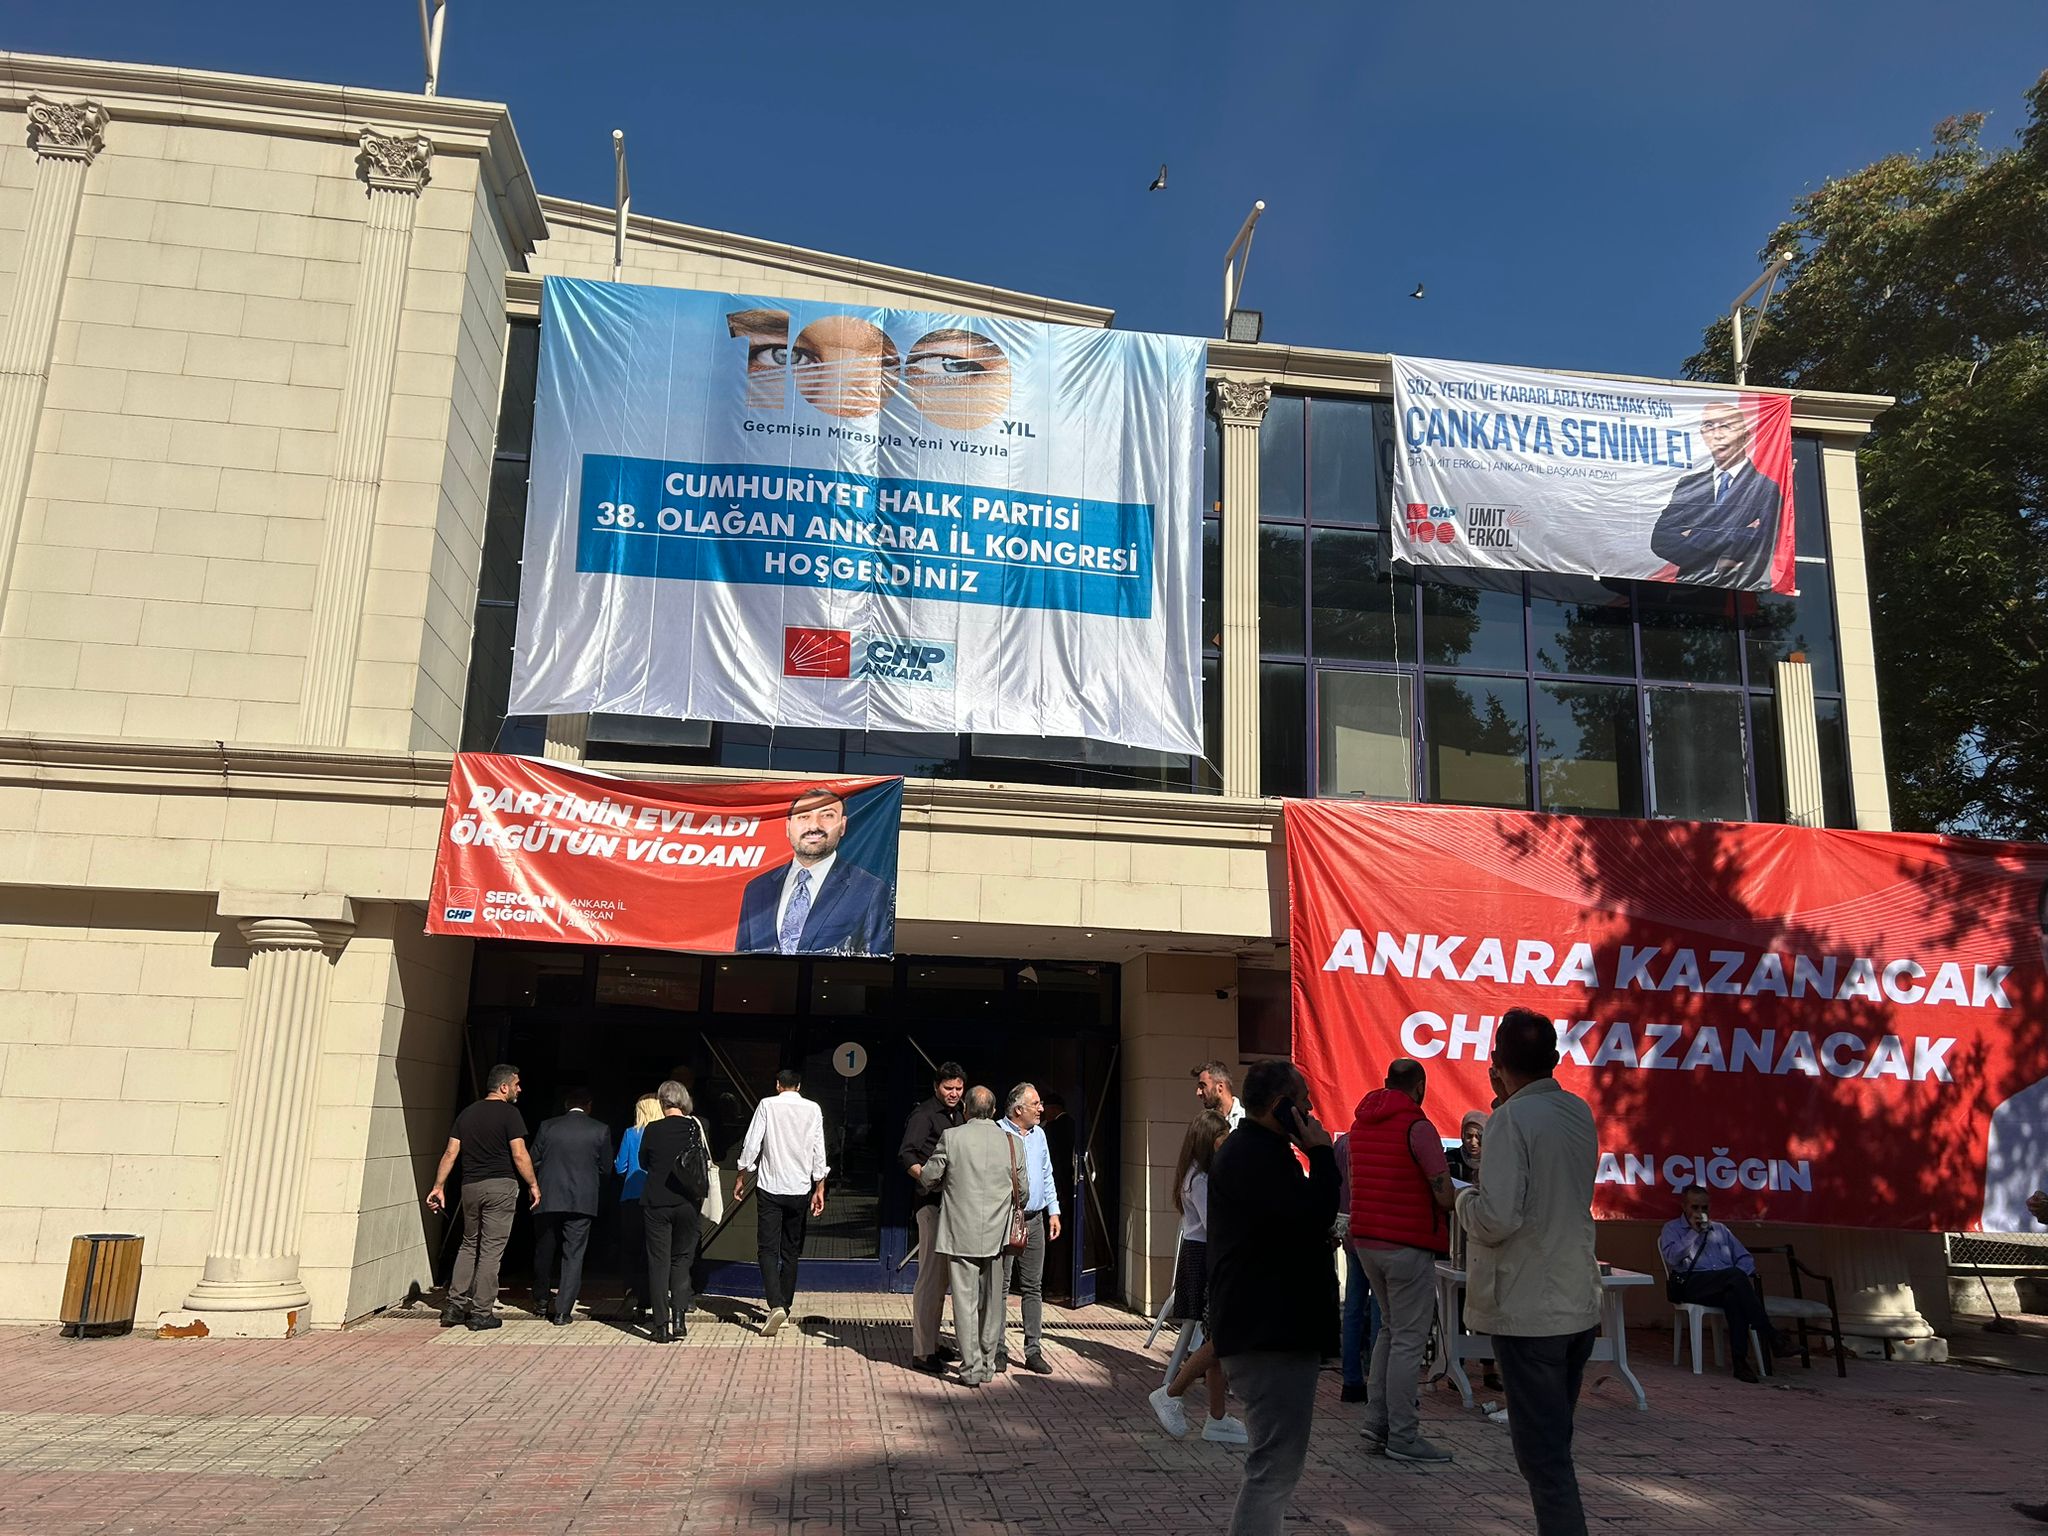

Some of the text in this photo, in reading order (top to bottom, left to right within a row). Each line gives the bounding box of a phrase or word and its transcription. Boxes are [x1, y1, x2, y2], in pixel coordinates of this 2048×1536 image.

[1408, 376, 1673, 419] SÖZ, YETKİ VE KARARLARA KATILMAK İÇİN
[743, 420, 1008, 457] Geçmişin Mirasıyla Yeni Yüzyıla
[1406, 406, 1554, 455] ÇANKAYA
[1561, 417, 1692, 469] SENİNLE!
[1453, 459, 1485, 470] ERKOL
[1493, 461, 1534, 473] ANKARA
[1547, 466, 1586, 478] BAŞKAN
[1589, 469, 1617, 480] ADAYI
[665, 472, 1080, 531] CUMHURİYET HALK PARTİSİ
[1430, 506, 1456, 518] CHP
[597, 502, 1137, 571] 38. OLAĞAN ANKARA İL KONGRESİ
[1406, 521, 1456, 544] 100
[1468, 528, 1513, 547] ERKOL
[765, 552, 980, 592] HOŞGELDİNİZ
[867, 641, 945, 668] CHP
[859, 662, 933, 682] ANKARA
[468, 786, 761, 837] PARTİNİN EVLADI
[450, 814, 766, 867] ÖRGÜTÜN VİCDANI
[446, 910, 473, 920] CHP
[482, 905, 544, 923] ÇIĞGIN
[569, 909, 613, 920] AŞKAN
[570, 899, 627, 910] ANKARA İL
[1322, 928, 2013, 1008] ANKARA KAZANACAK
[846, 1050, 855, 1069] 1
[1400, 1011, 1957, 1082] CH KAZANACAK
[1662, 1147, 1812, 1193] ÇIĞGIN
